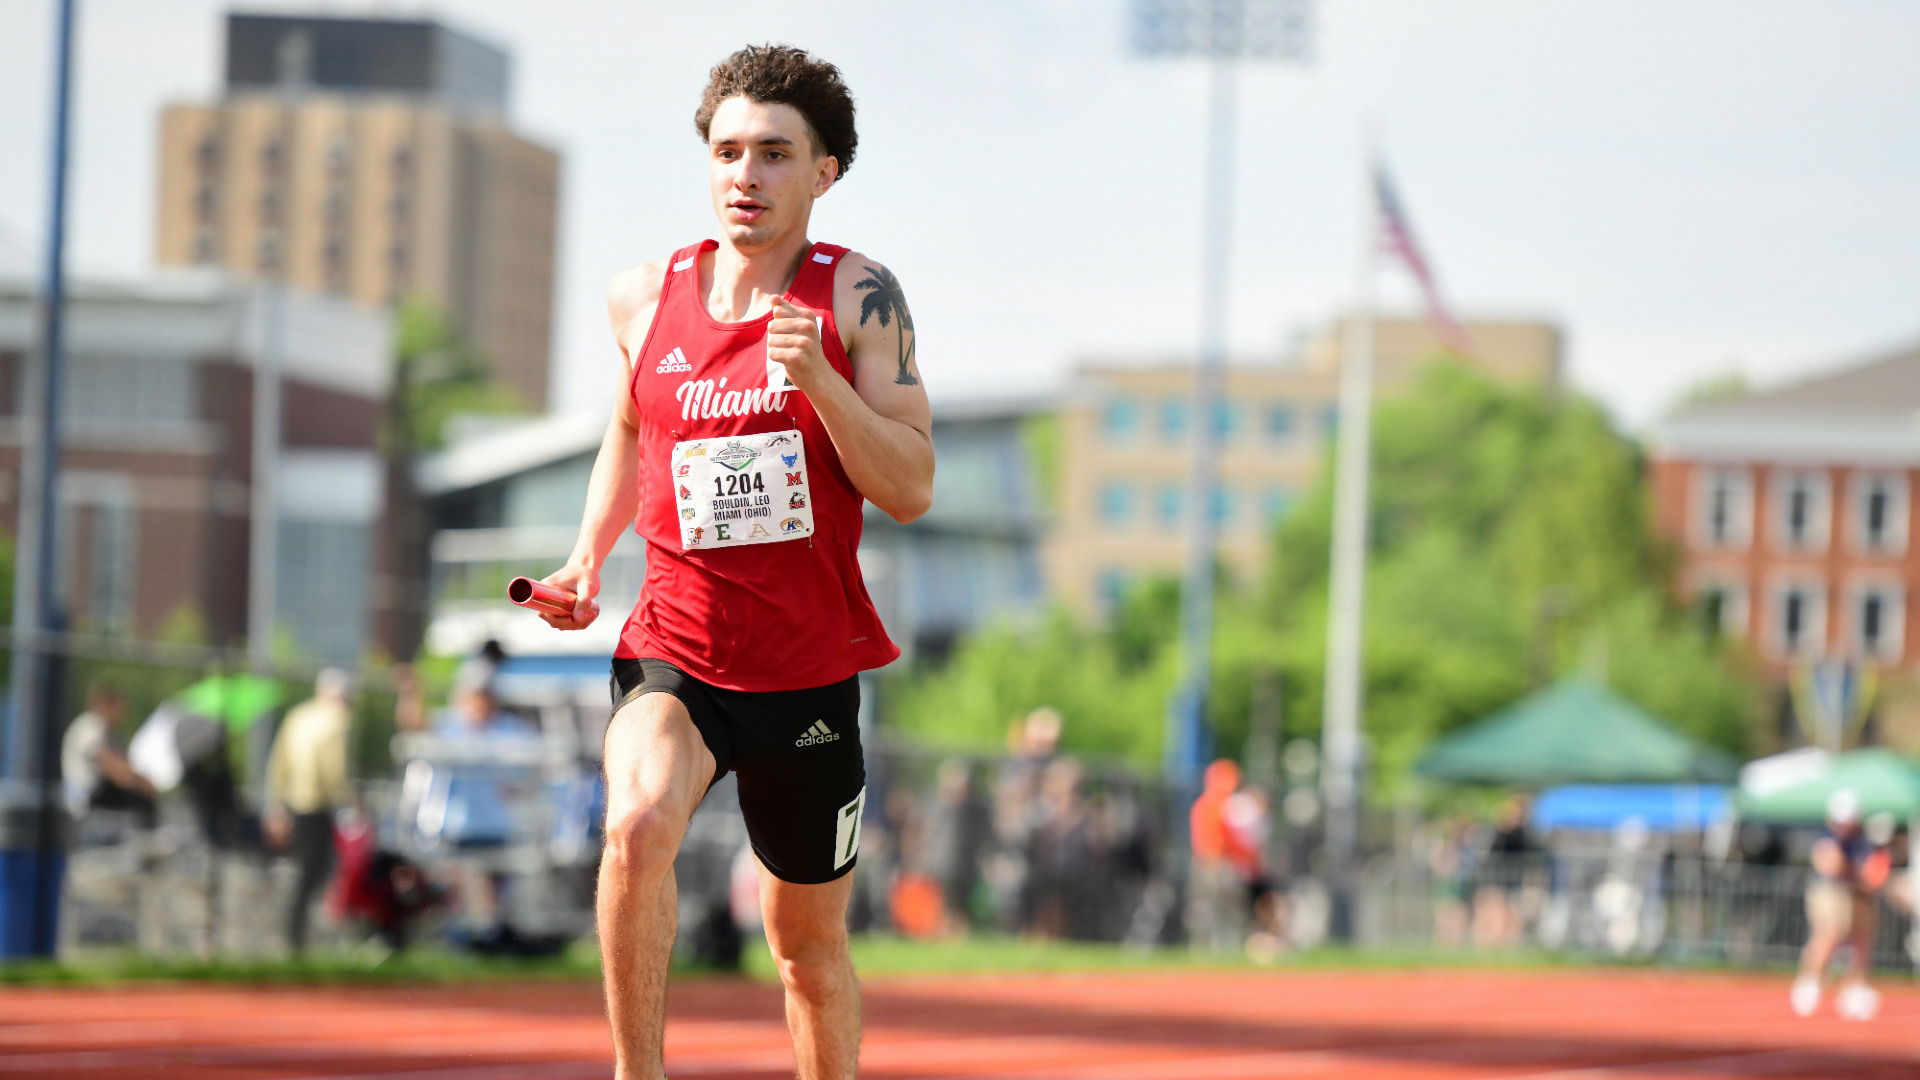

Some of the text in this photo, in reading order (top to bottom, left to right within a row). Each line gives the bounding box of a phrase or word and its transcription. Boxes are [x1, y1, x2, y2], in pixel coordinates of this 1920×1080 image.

[656, 363, 692, 374] adidas
[714, 472, 765, 496] 1204
[785, 471, 803, 486] M
[713, 495, 770, 510] BOULDIN, LEO
[714, 506, 773, 521] MIAMI (OHIO)
[715, 523, 731, 541] E
[749, 523, 771, 538] A
[795, 731, 840, 747] adidas
[845, 796, 860, 860] 7
